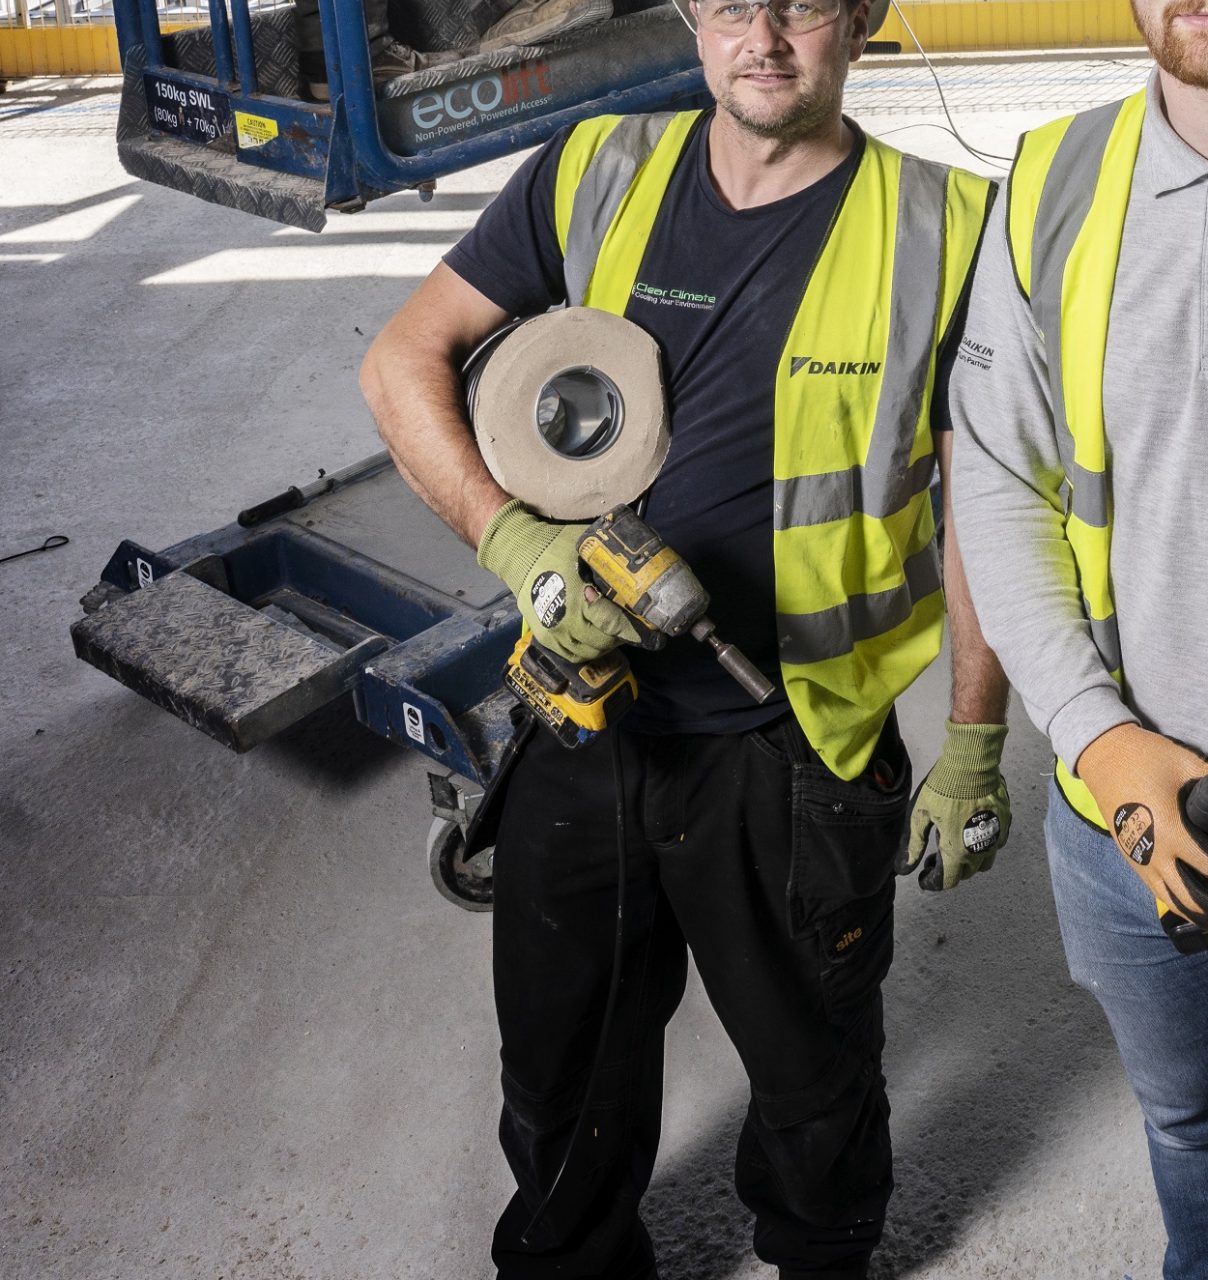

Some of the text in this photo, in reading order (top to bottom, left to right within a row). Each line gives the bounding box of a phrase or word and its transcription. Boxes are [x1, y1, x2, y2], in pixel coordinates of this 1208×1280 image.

[155, 82, 215, 111] 150kg SWL
[415, 116, 480, 143] Non-Powered,
[480, 104, 519, 123] Powered
[634, 292, 658, 305] Cooling
[660, 297, 674, 306] Your
[636, 282, 717, 304] Clear Climate
[808, 361, 881, 375] DAIKIN
[967, 357, 992, 370] Partner
[835, 927, 863, 952] site
